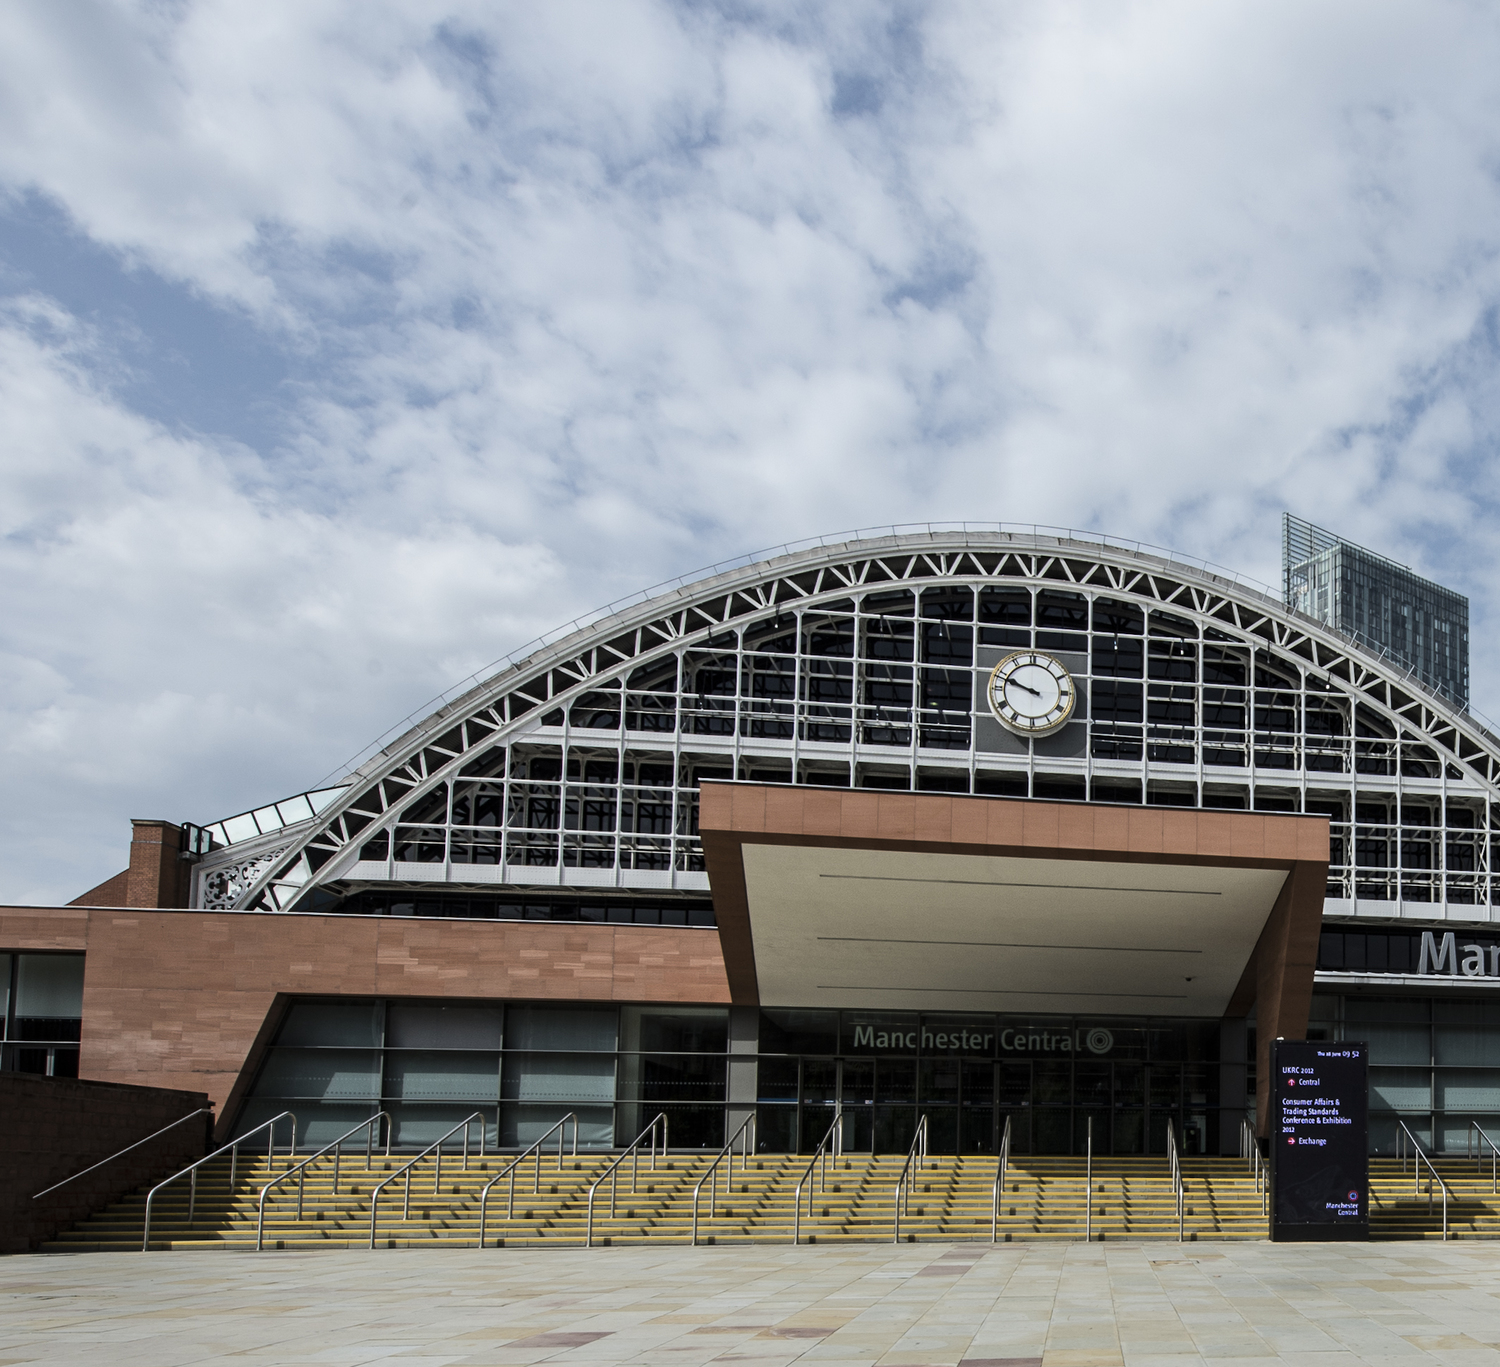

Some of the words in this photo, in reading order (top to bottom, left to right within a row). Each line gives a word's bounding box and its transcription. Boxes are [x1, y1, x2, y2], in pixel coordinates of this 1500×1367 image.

[853, 1025, 993, 1049] Manchester
[1000, 1029, 1082, 1051] Central
[1298, 1078, 1320, 1086] Central
[1283, 1108, 1307, 1116] Trading
[1298, 1137, 1327, 1146] Exchange
